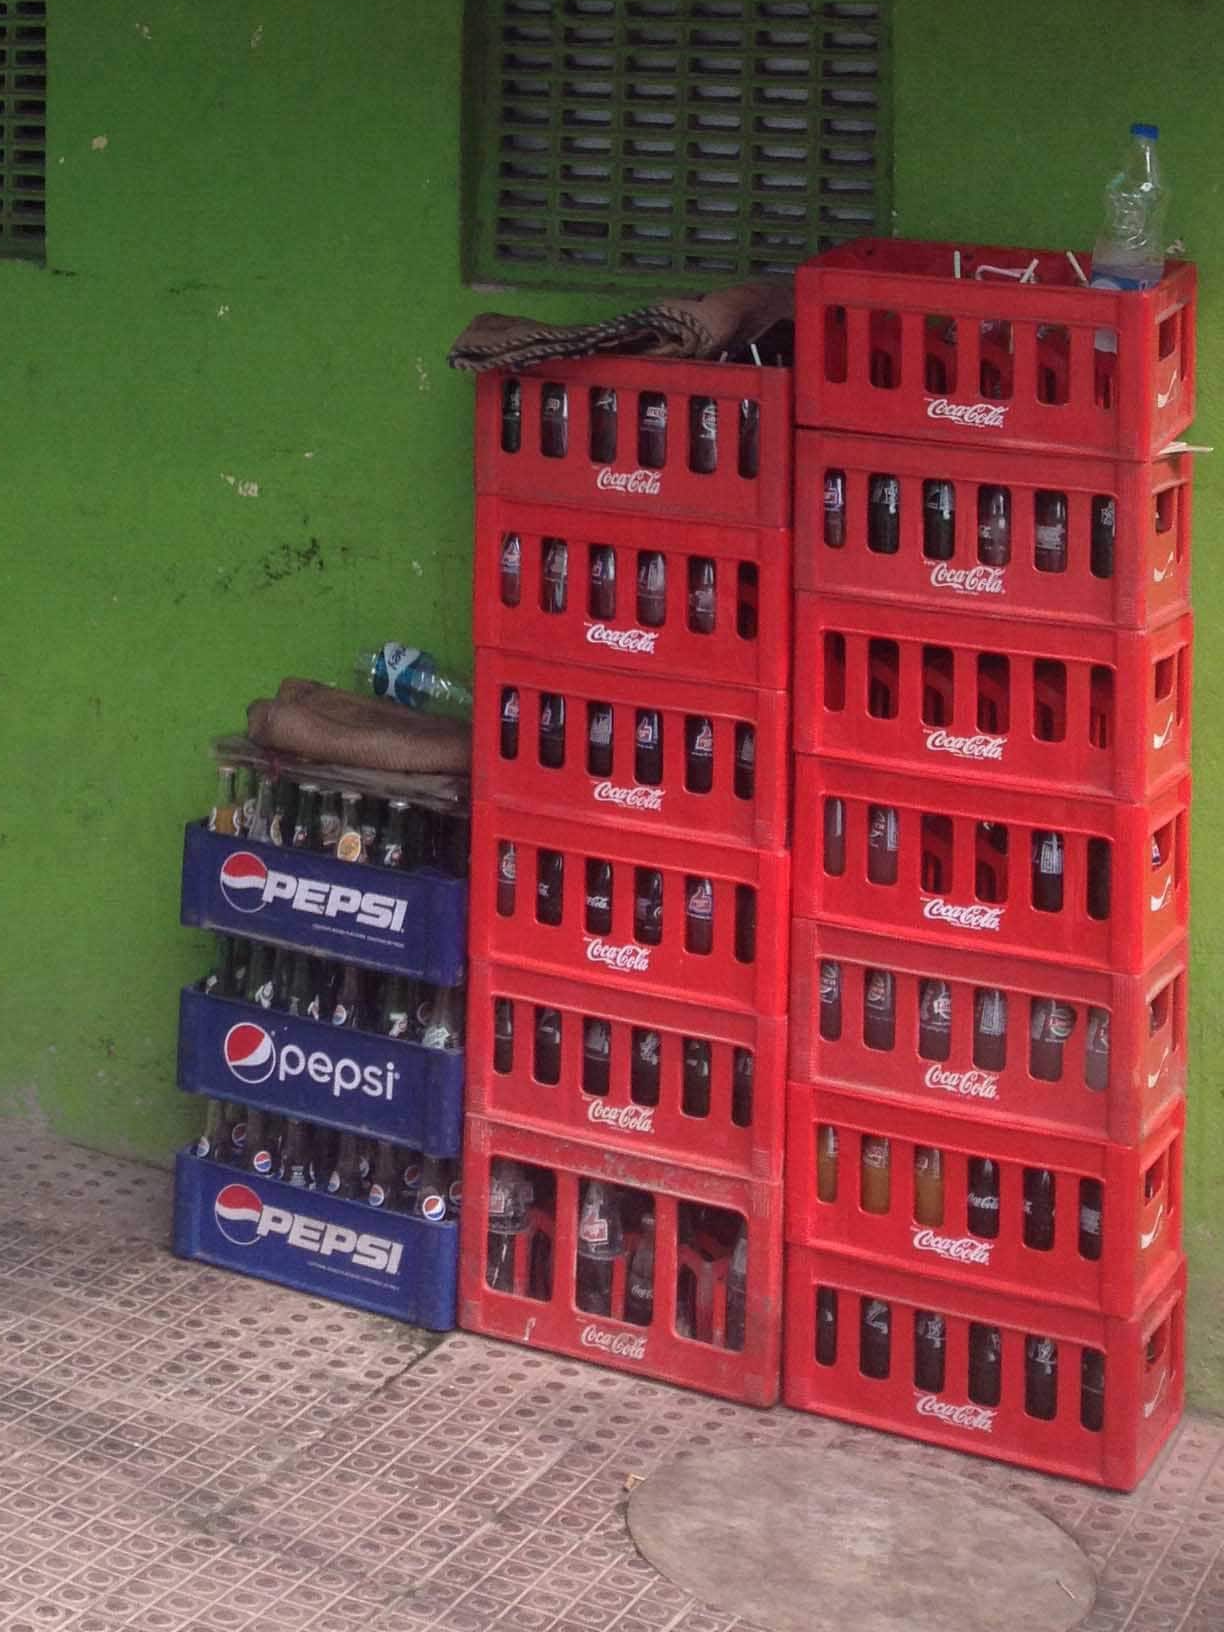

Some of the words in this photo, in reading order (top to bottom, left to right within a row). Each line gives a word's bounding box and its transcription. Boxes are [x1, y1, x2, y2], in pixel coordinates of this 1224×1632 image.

[262, 870, 408, 932] PEPSI
[278, 1043, 398, 1100] pepsi
[256, 1204, 404, 1275] PEPSI
